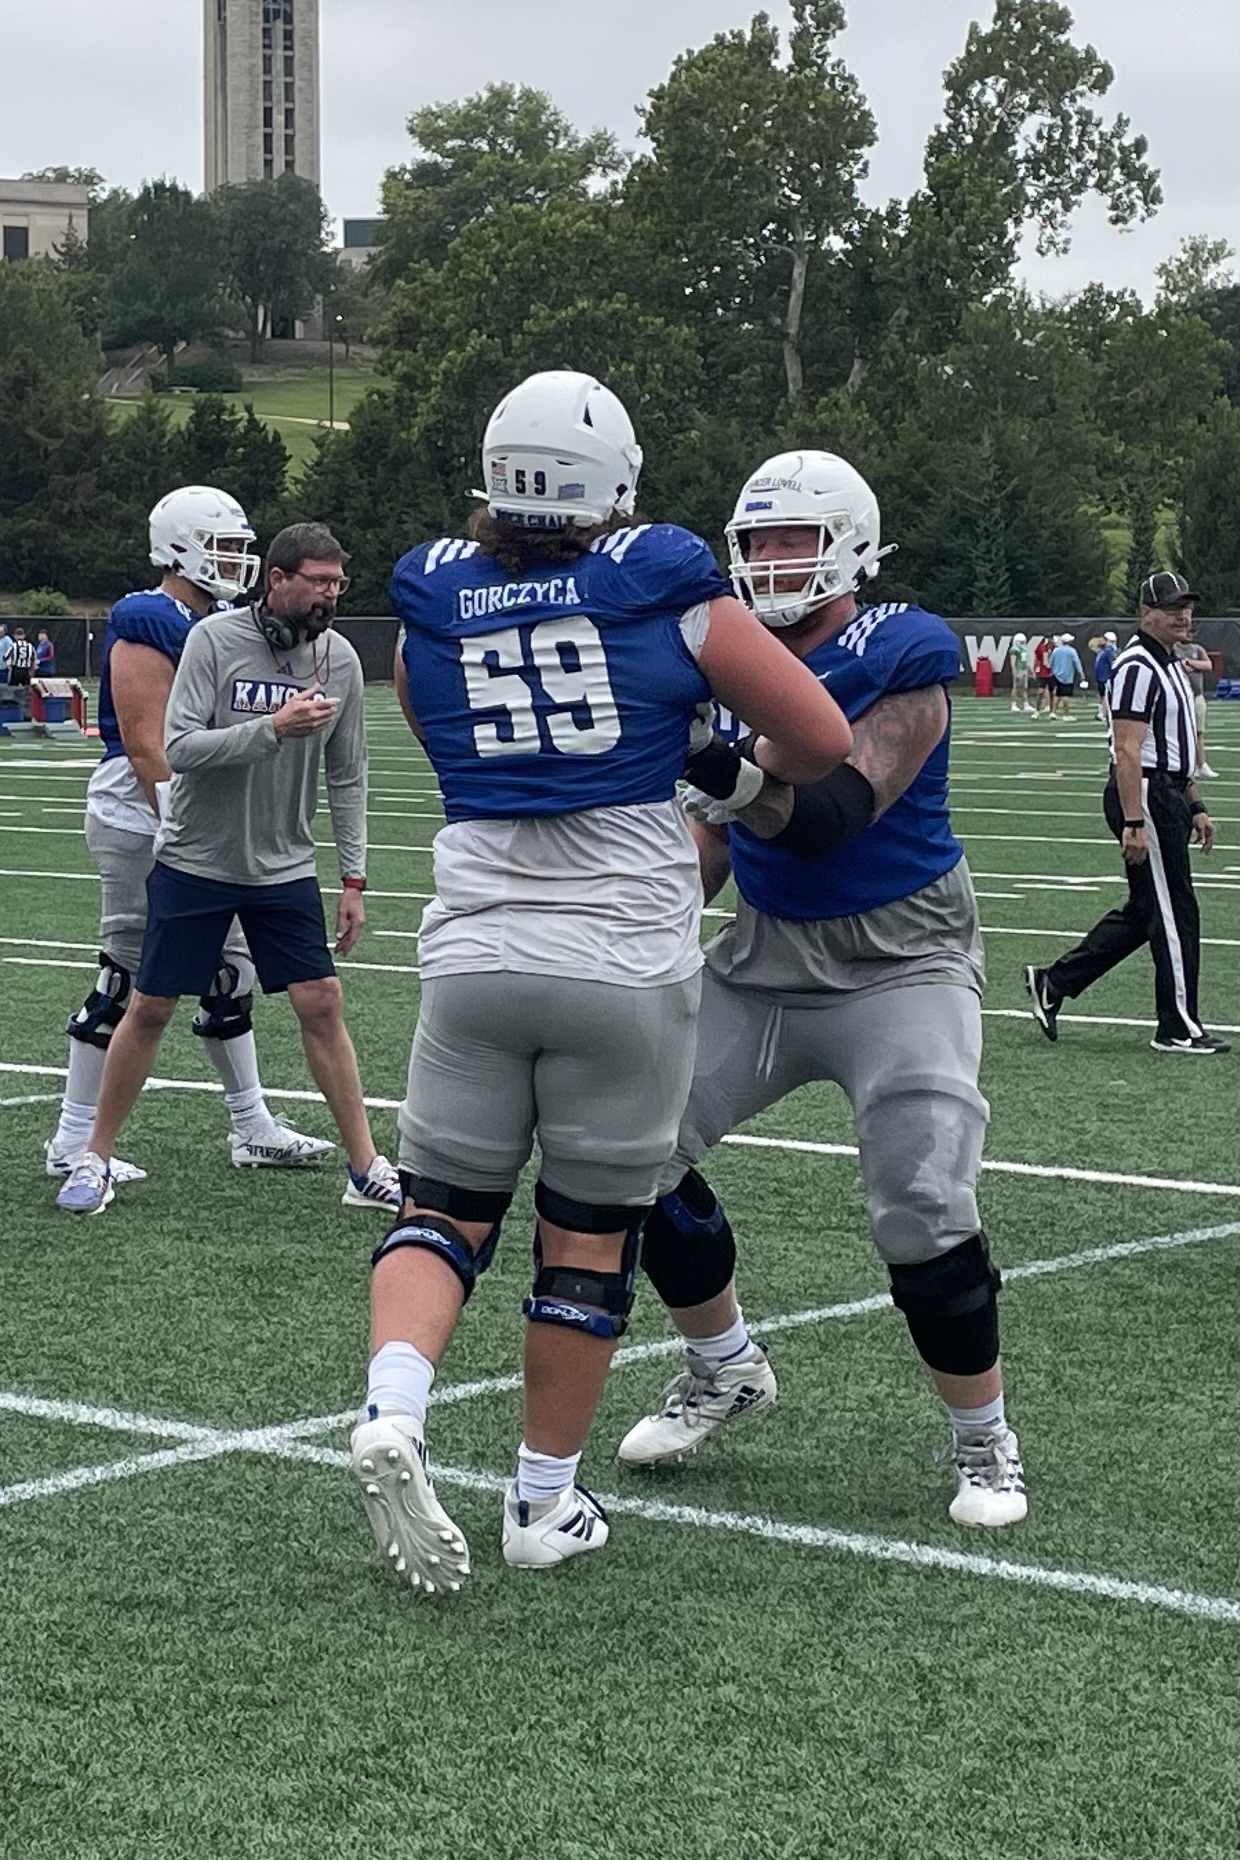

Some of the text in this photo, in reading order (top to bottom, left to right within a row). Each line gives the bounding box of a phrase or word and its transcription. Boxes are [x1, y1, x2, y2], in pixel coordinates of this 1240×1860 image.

[515, 469, 547, 496] 59
[459, 577, 581, 619] GORCZYCA
[460, 615, 622, 759] 59
